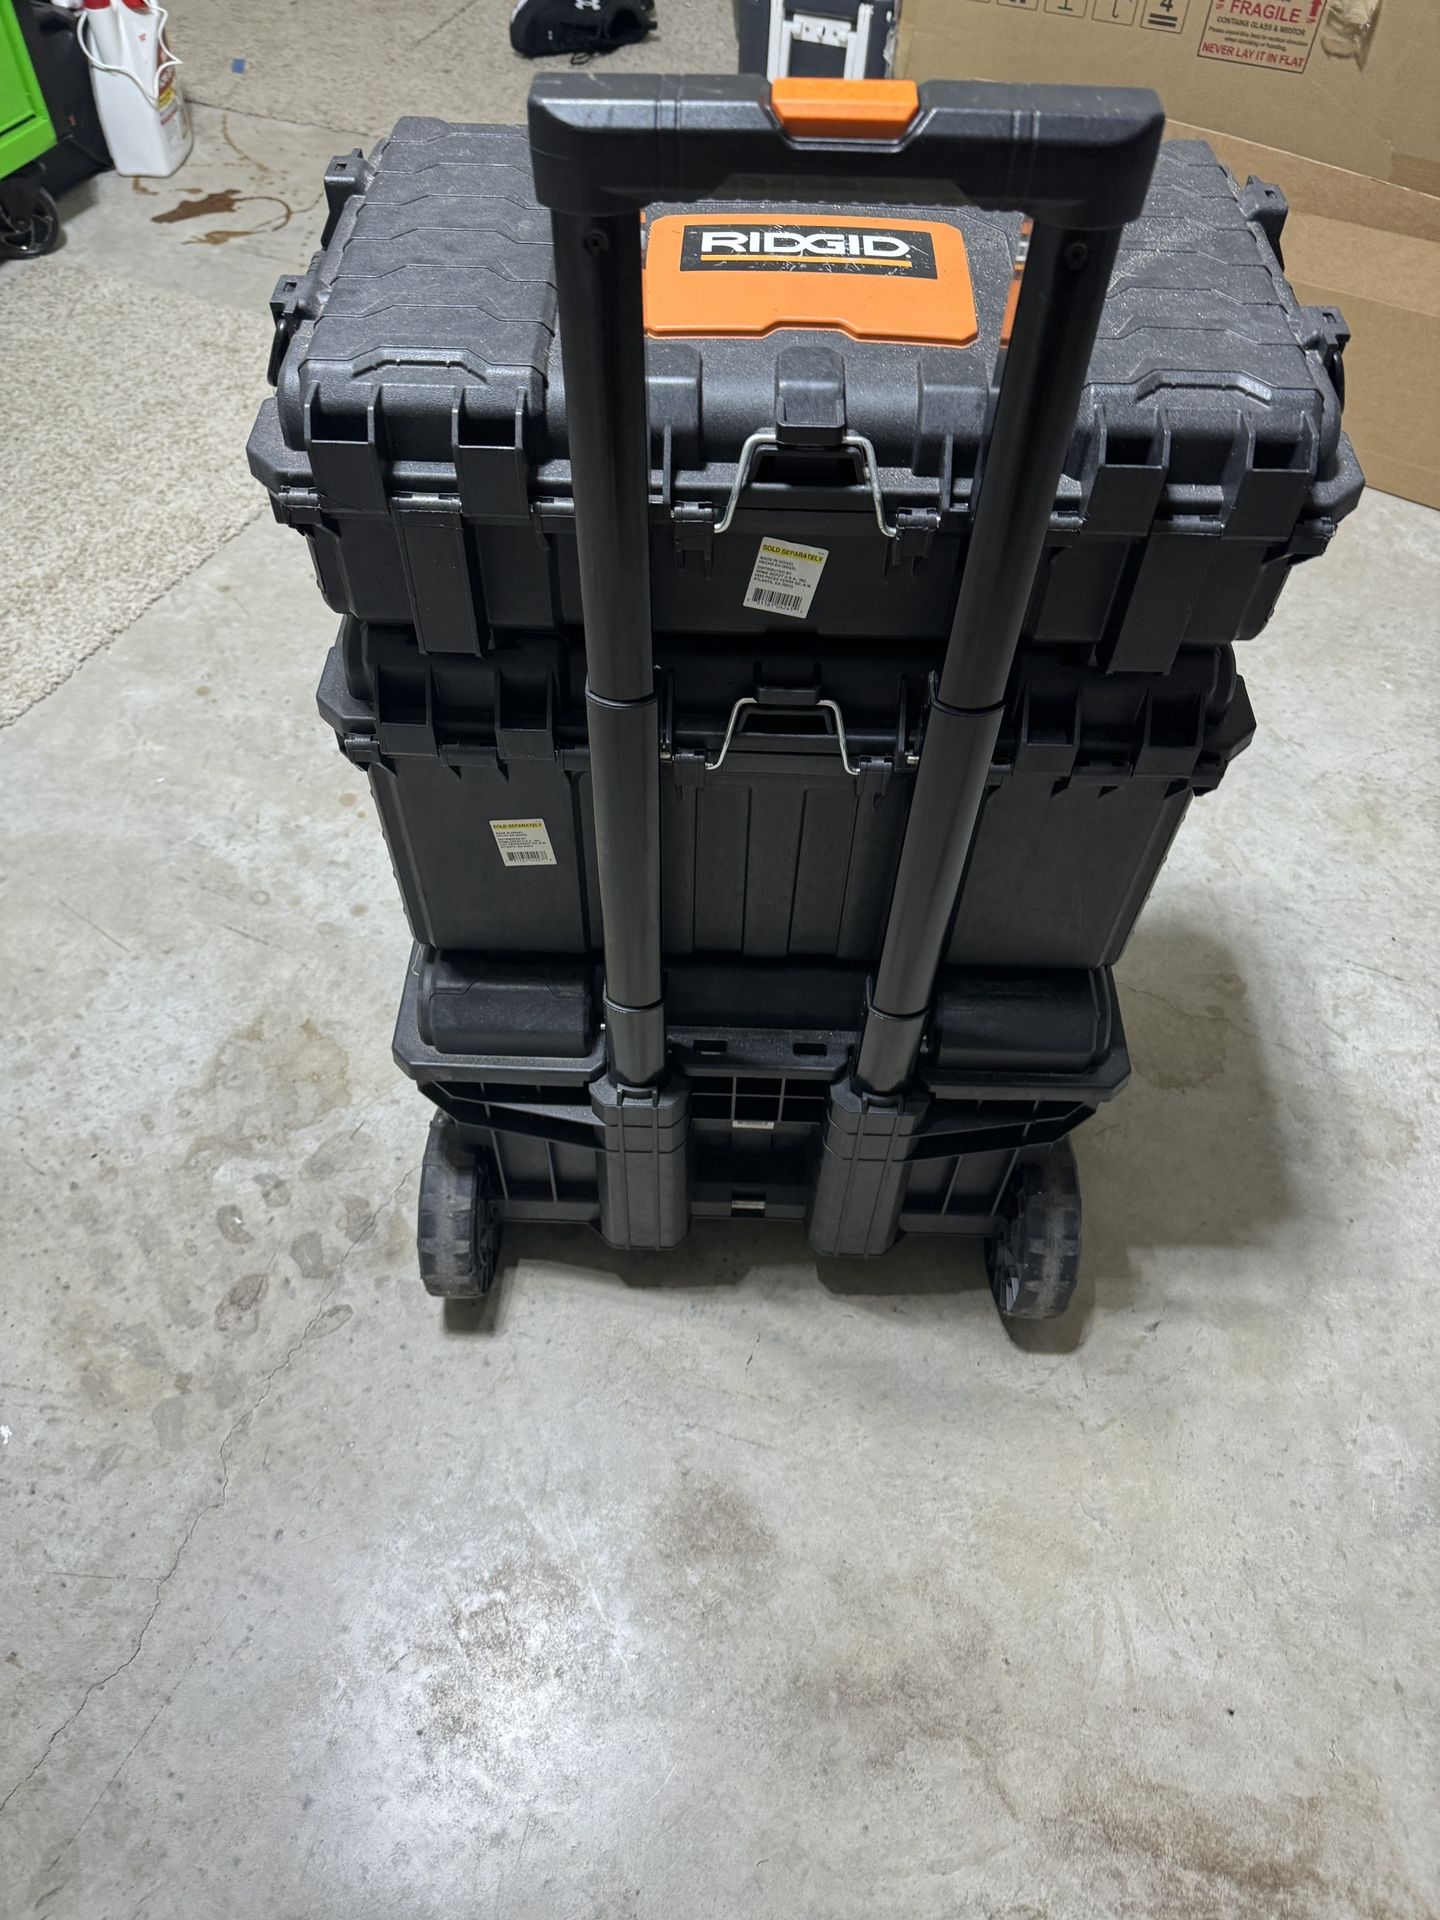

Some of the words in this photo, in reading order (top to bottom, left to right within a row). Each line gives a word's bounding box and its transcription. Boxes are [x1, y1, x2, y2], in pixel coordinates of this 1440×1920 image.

[1217, 16, 1250, 28] CONTAINS
[1251, 21, 1272, 31] GLASS
[1230, 0, 1302, 24] FRAGILE
[1202, 42, 1234, 56] NEVER
[1235, 48, 1254, 60] LAY
[1255, 50, 1266, 61] IT
[1267, 52, 1278, 63] IN
[1279, 55, 1306, 68] FLAT
[701, 231, 911, 259] RIDGID
[763, 544, 781, 553] SOLD
[781, 548, 824, 562] SEPARATELY
